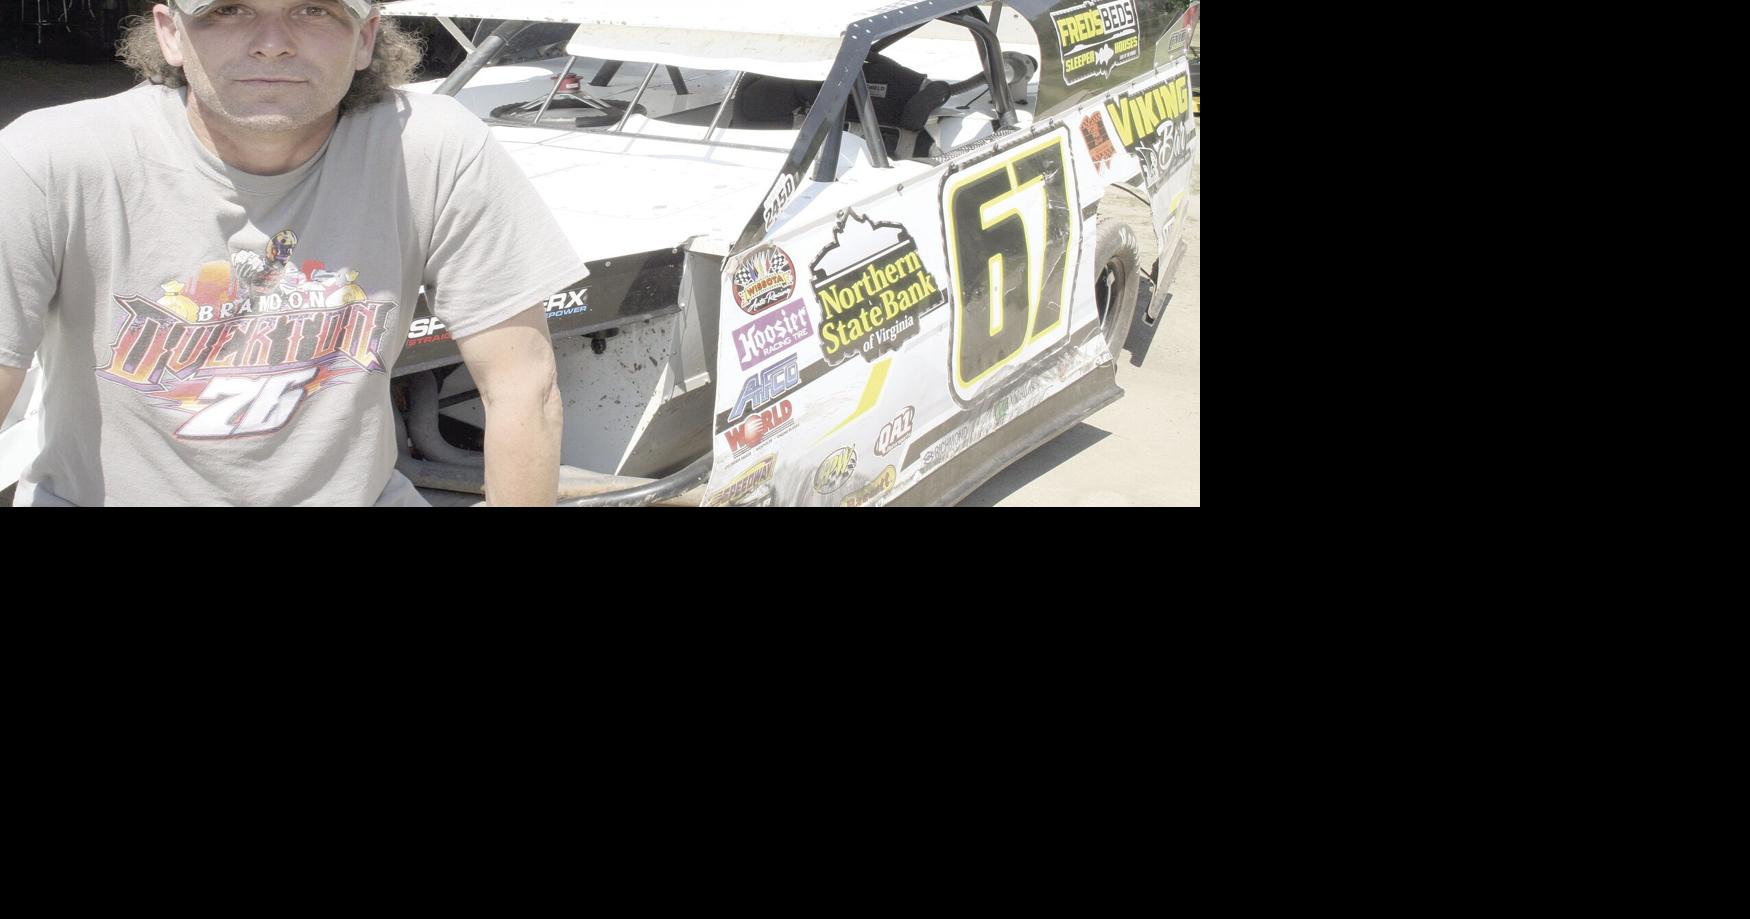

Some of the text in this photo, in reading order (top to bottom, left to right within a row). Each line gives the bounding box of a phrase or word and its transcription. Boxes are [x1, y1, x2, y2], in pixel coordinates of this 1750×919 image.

[1101, 2, 1134, 32] BEDS
[1065, 50, 1095, 73] SLEEPER
[1114, 36, 1138, 54] HOUSES
[1107, 75, 1188, 147] VIKING
[746, 273, 785, 296] WISSOTA
[818, 250, 922, 319] Northern
[952, 135, 1071, 389] 67
[198, 291, 325, 322] BRANDON
[821, 272, 938, 354] State Bank
[97, 292, 398, 391] OVERTON
[738, 305, 808, 363] Hoosier
[763, 328, 808, 355] RACING TIRE
[862, 316, 914, 353] of Virginia
[727, 352, 800, 424] AFCO
[724, 399, 793, 451] WORLD
